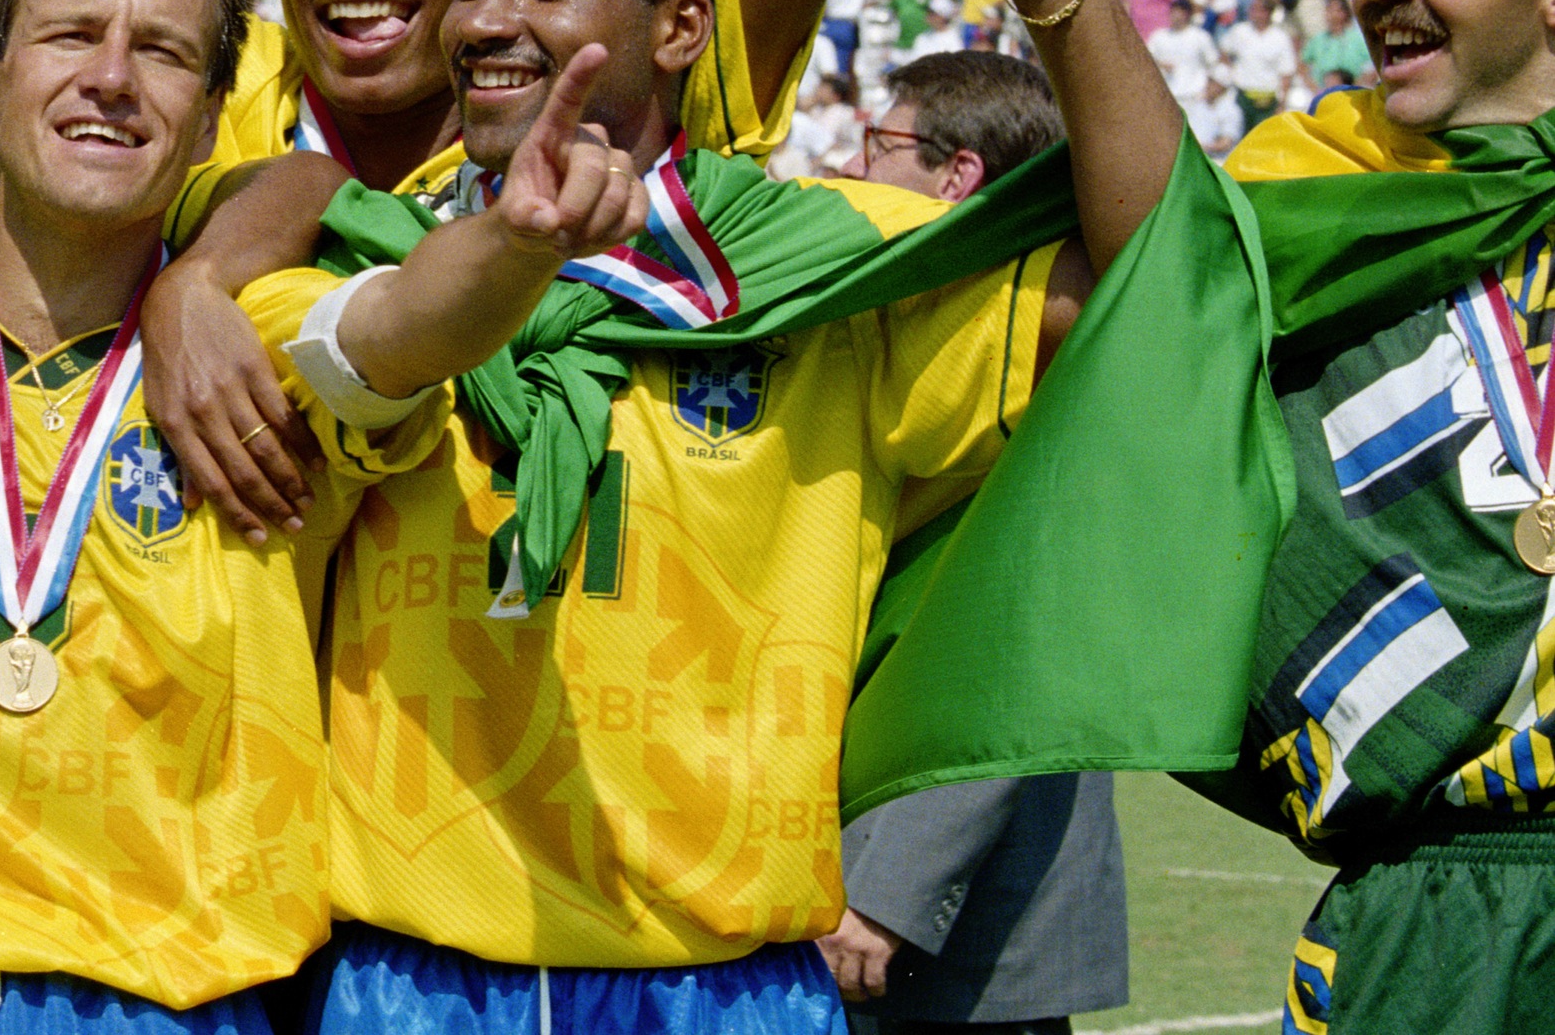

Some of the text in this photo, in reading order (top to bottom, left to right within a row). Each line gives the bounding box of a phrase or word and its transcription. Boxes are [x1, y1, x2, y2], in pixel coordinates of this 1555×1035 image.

[54, 353, 82, 378] CBF
[696, 370, 737, 390] CBF
[685, 445, 742, 463] BRASIL
[130, 467, 166, 489] CBF
[374, 552, 486, 614] CBF
[558, 683, 673, 735] CBF
[20, 746, 132, 797] CBF
